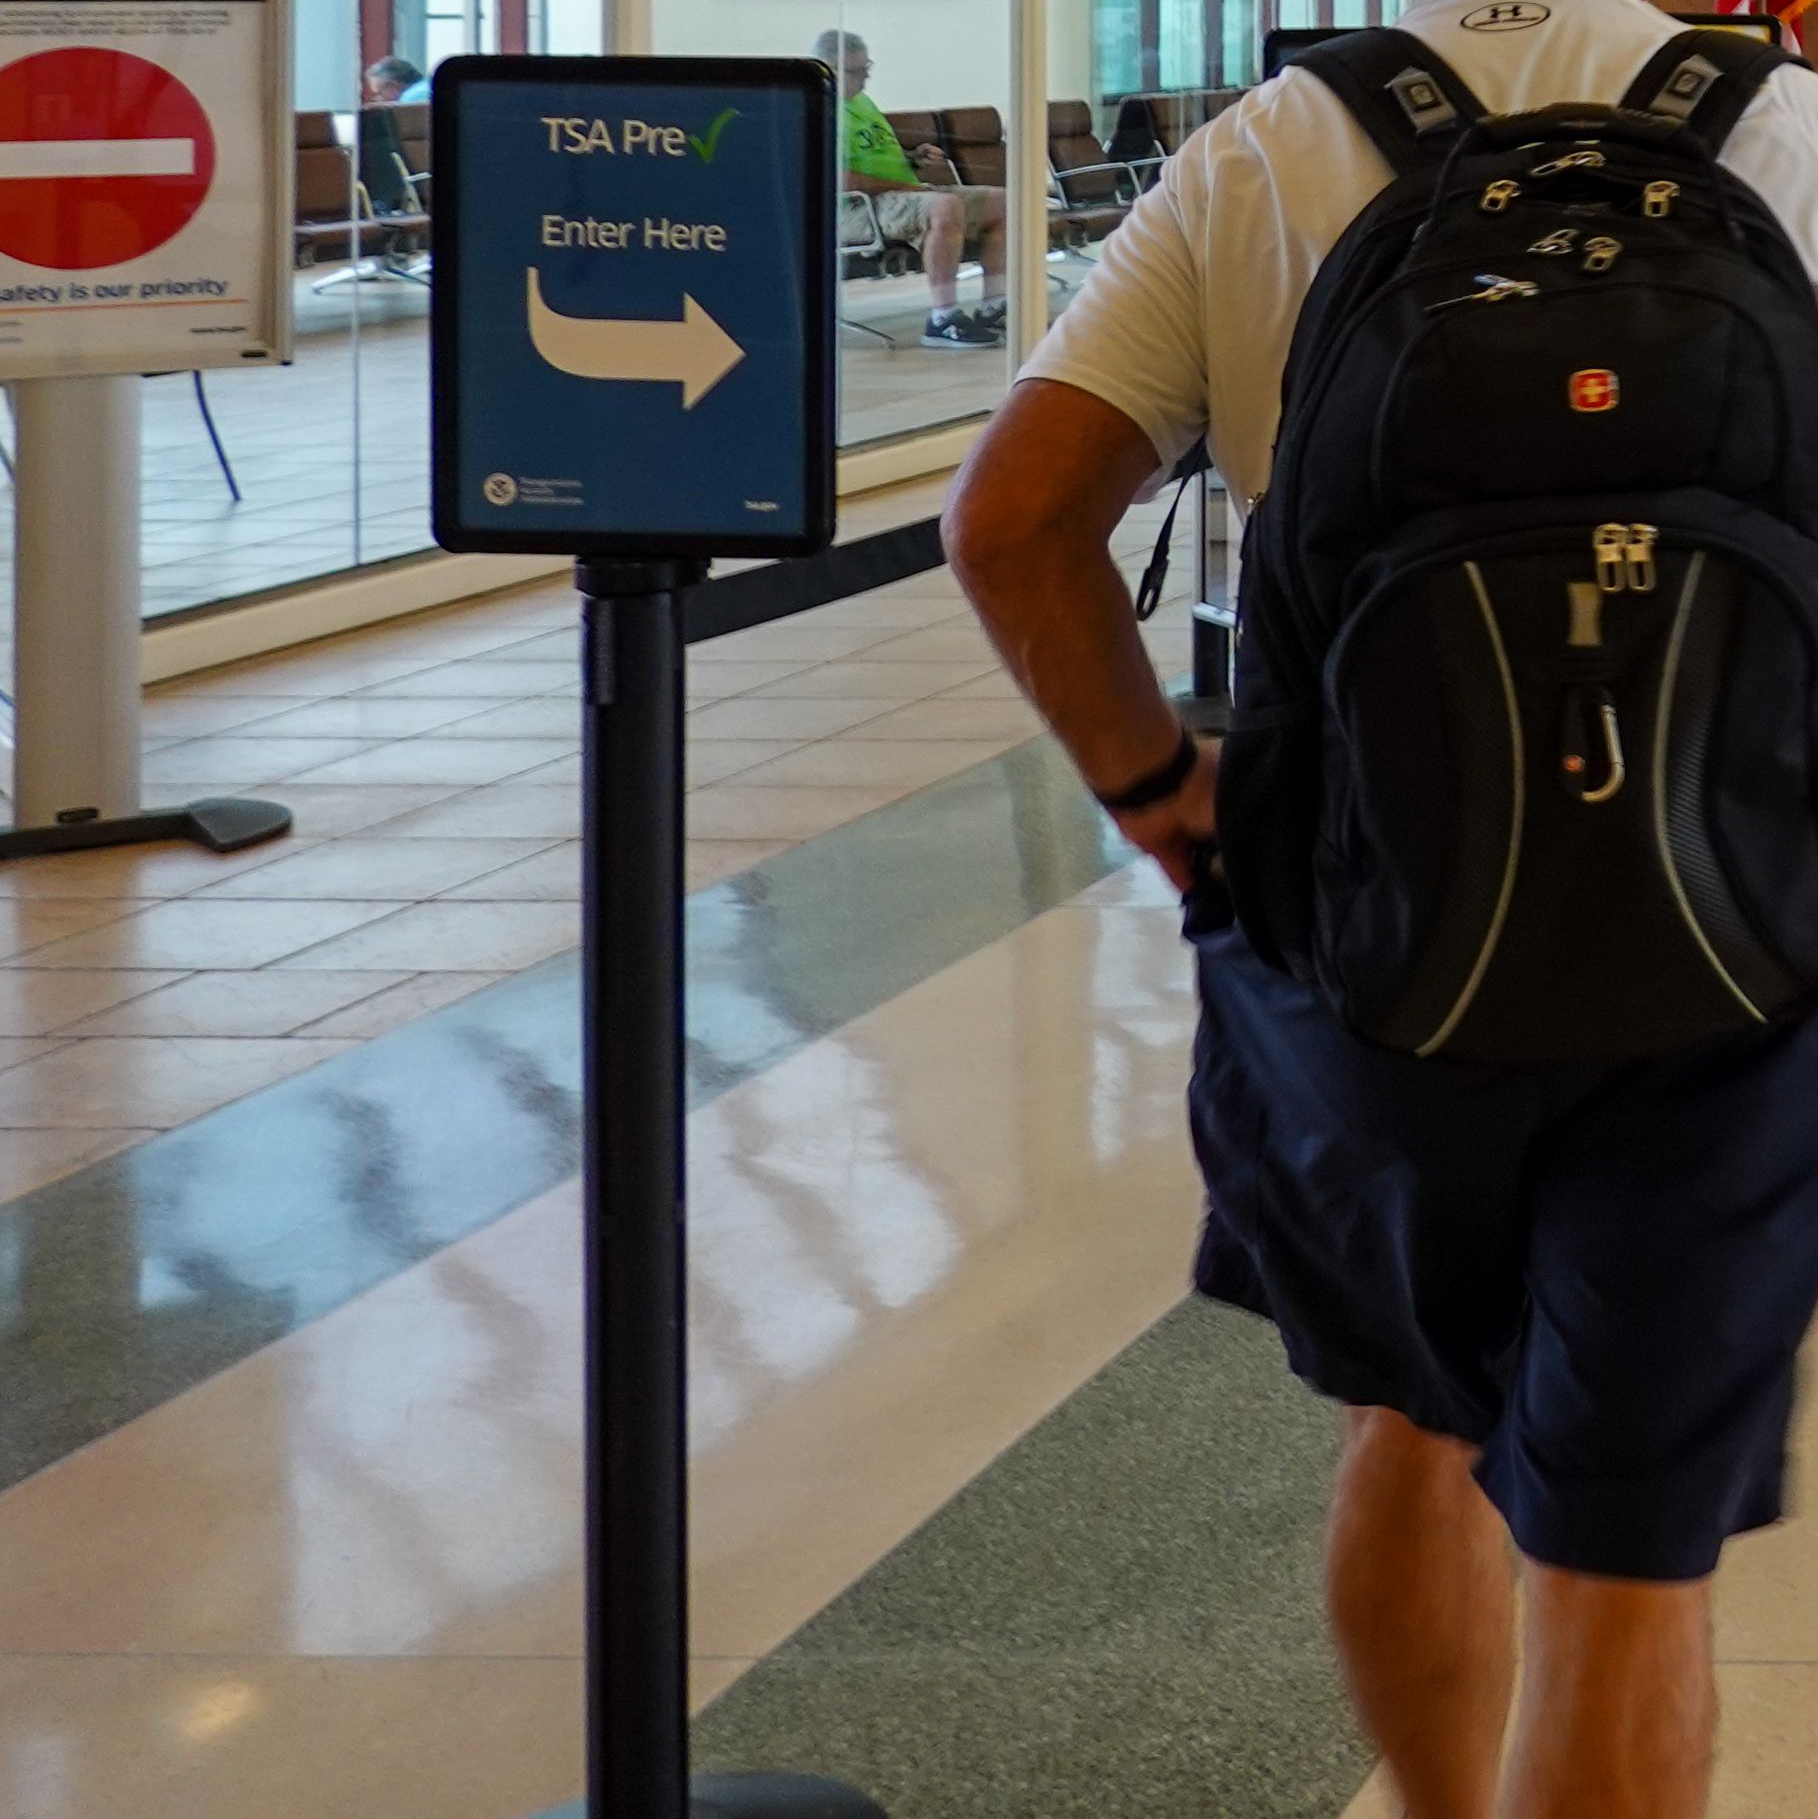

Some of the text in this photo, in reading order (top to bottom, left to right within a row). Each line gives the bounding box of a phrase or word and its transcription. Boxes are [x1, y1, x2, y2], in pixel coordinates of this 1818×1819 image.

[540, 116, 687, 157] TSA Pre
[541, 214, 727, 253] Enter Here
[0, 278, 228, 303] afety is our priority
